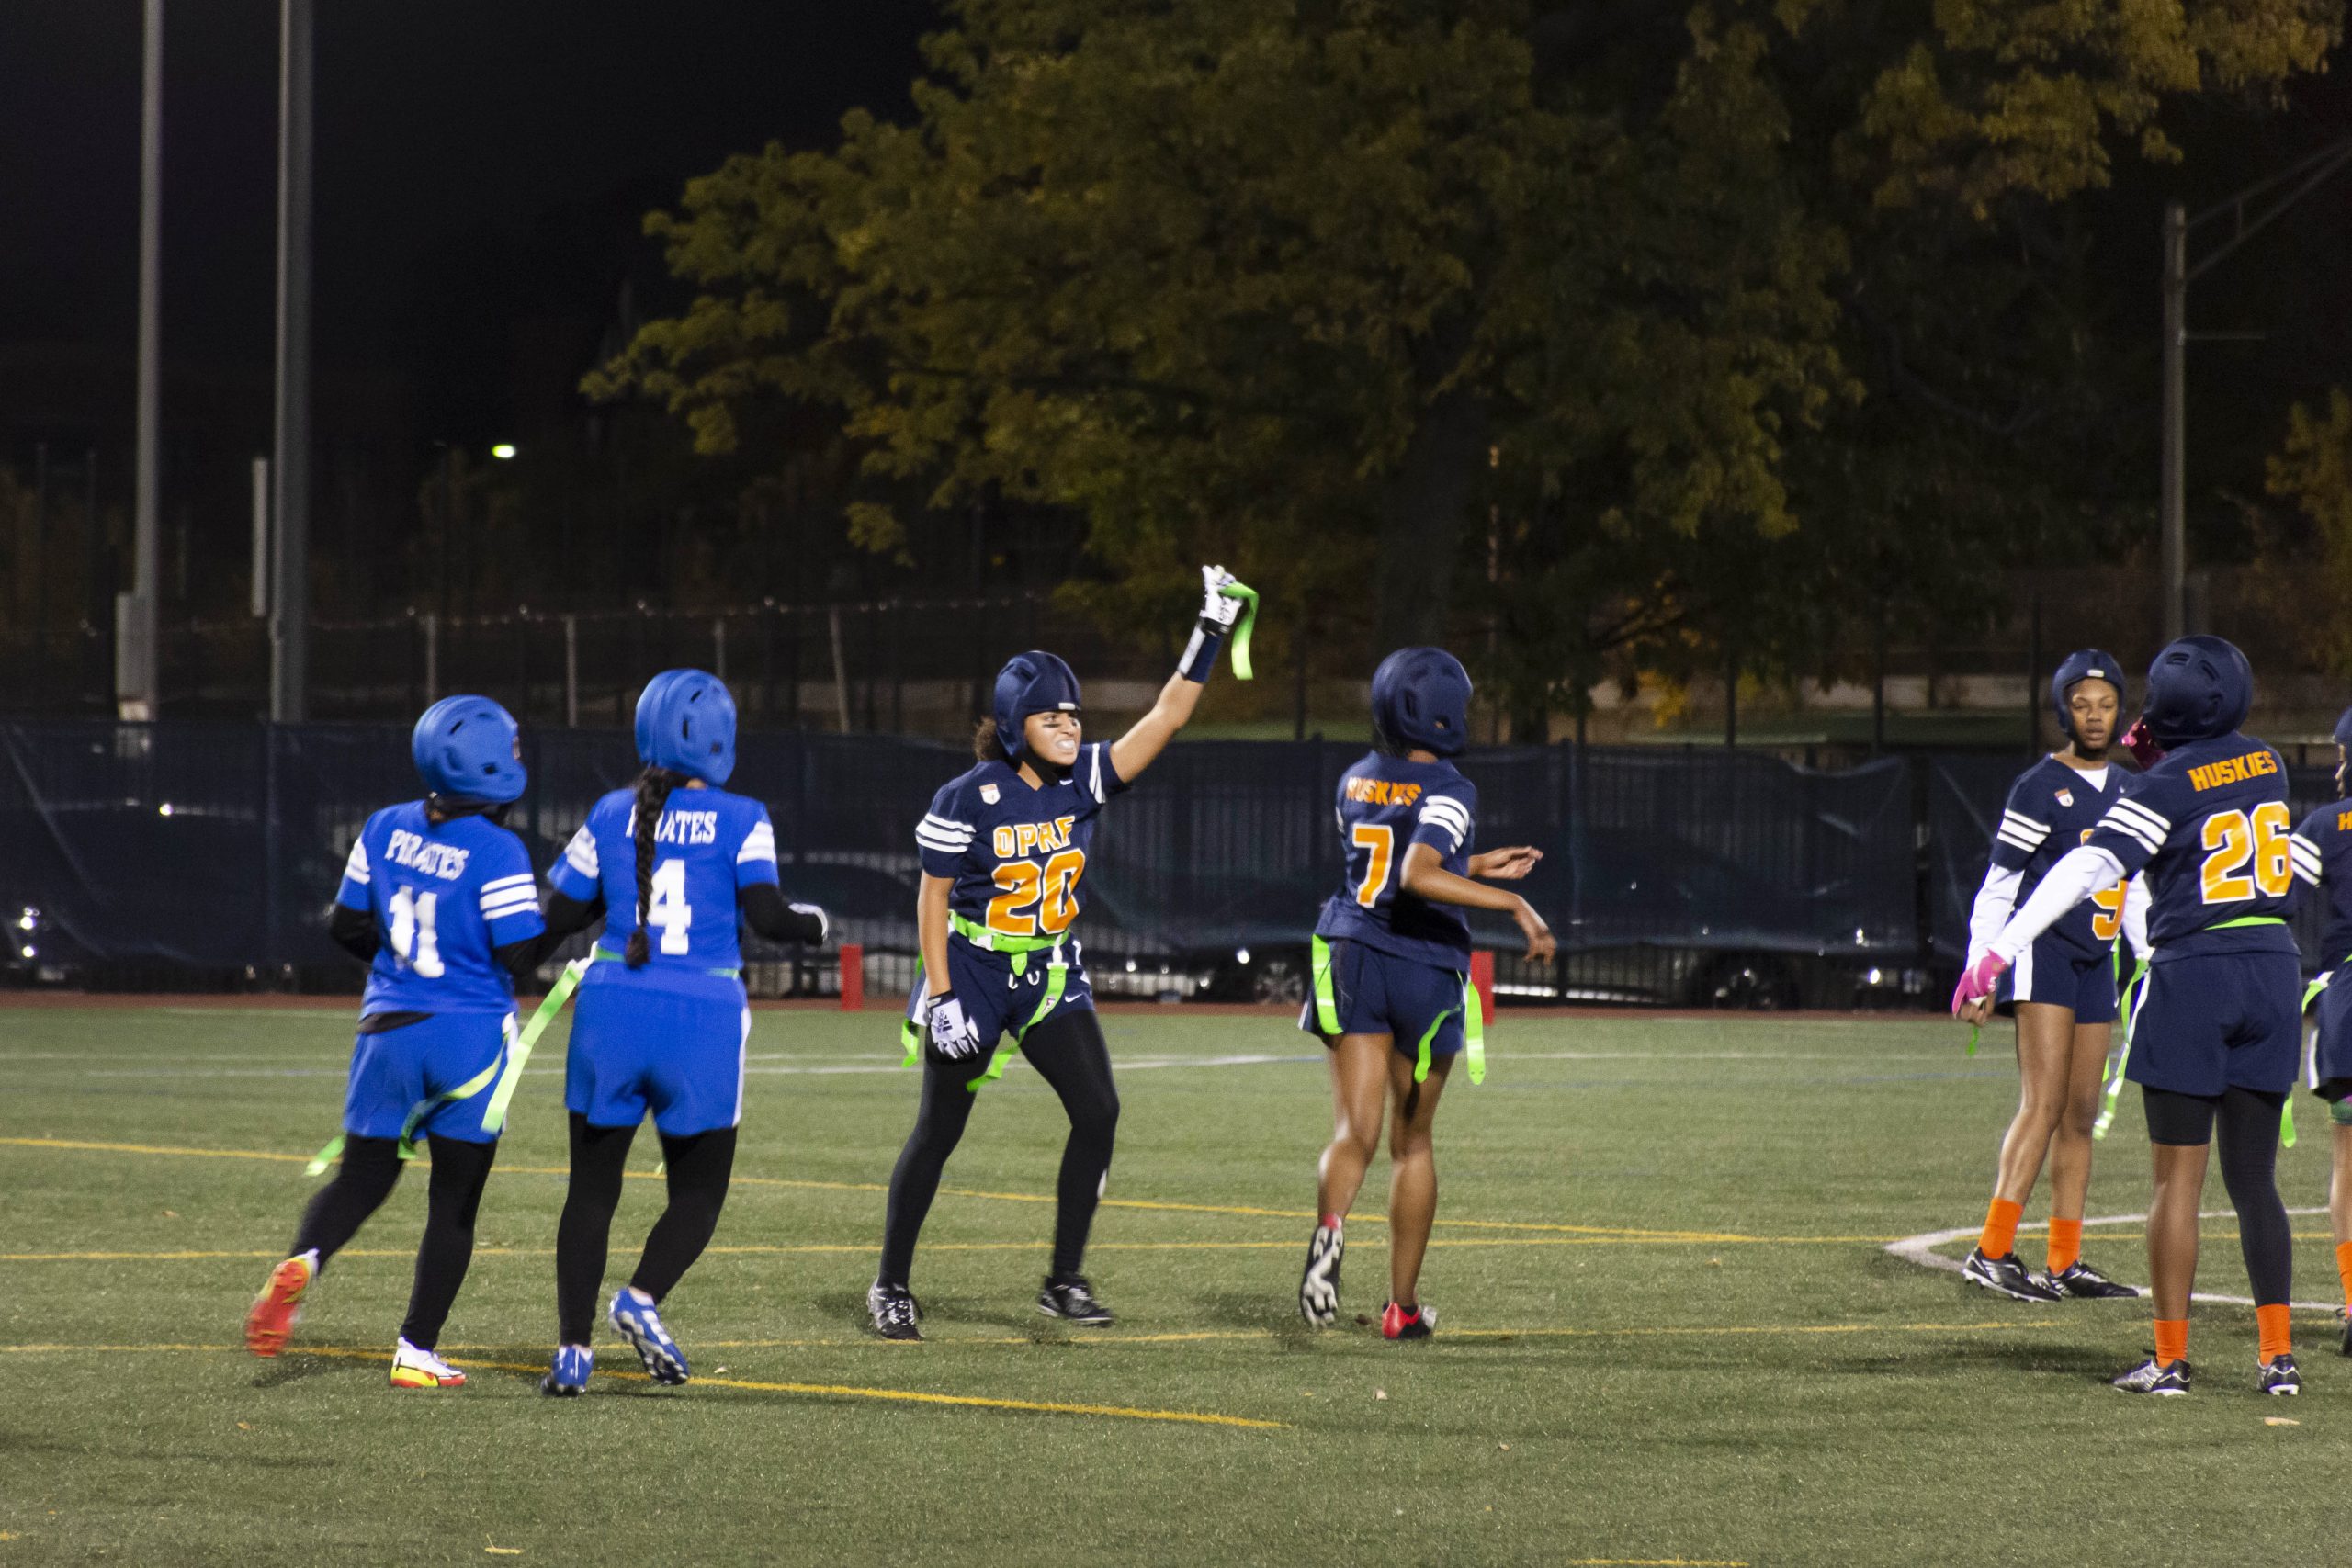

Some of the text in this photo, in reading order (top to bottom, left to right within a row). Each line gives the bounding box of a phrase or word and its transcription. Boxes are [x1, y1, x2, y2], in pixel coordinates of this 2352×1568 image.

[2187, 750, 2278, 792] HUSKIES
[384, 829, 470, 881] PIRATES
[625, 804, 718, 845] ATES
[993, 816, 1076, 858] OPRF
[1352, 823, 1395, 908] 7
[2200, 801, 2294, 905] 26
[389, 885, 445, 978] 11
[636, 859, 692, 955] 4
[986, 848, 1086, 936] 20
